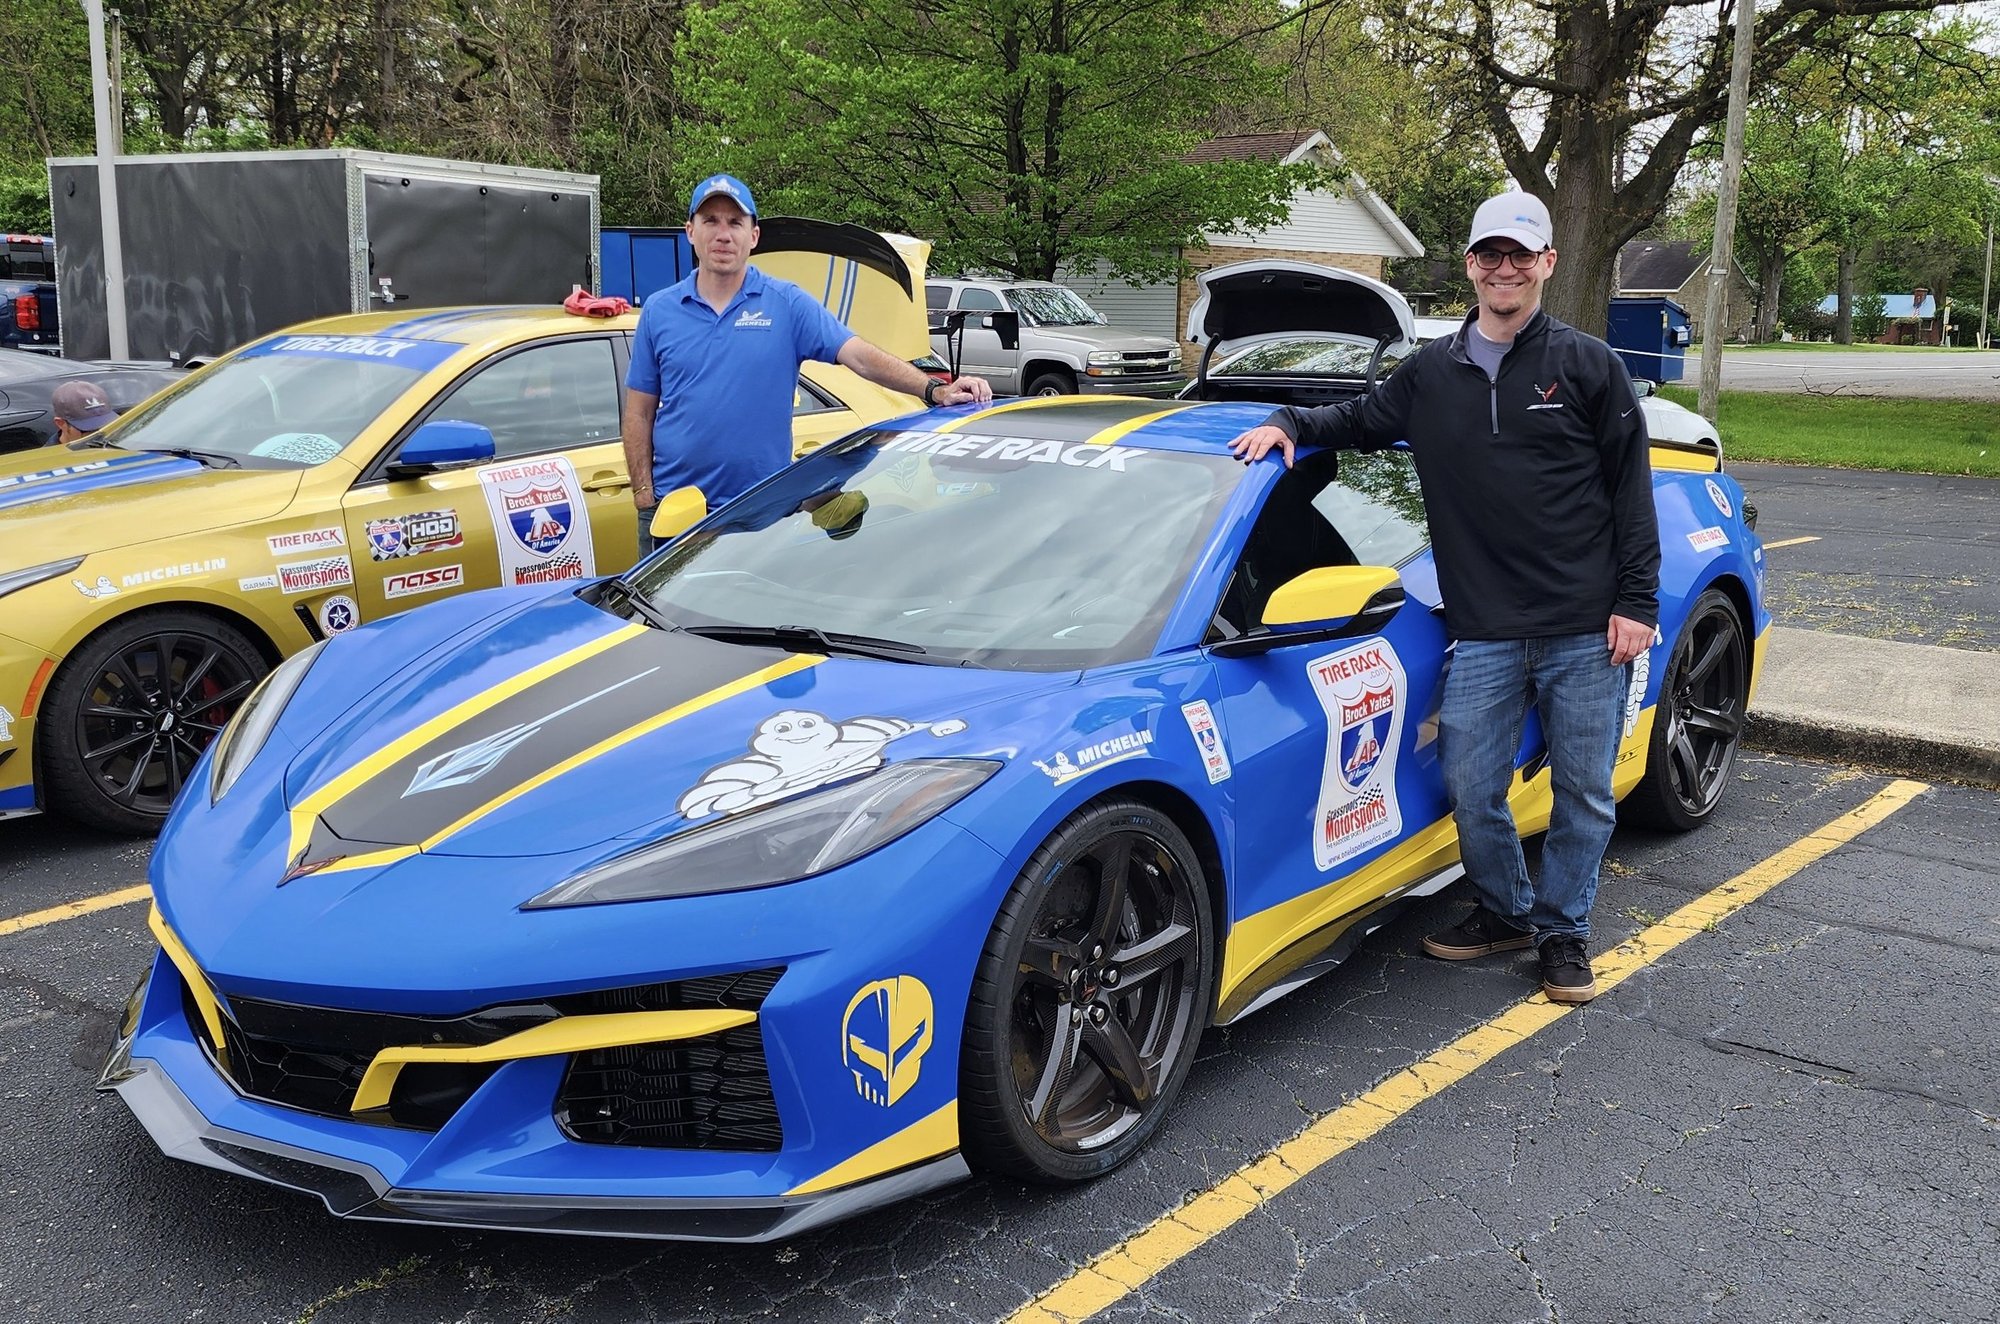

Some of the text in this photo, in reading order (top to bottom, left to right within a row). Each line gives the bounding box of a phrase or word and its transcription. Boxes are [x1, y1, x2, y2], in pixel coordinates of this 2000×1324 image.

[271, 336, 418, 358] TIRE RACK
[877, 431, 1149, 472] TIRE RACK
[488, 462, 565, 483] TIRE RACK
[508, 489, 564, 509] Brock Yates'
[411, 518, 453, 538] HOD
[529, 521, 561, 541] LAP
[269, 529, 343, 549] TIRE RACK
[122, 558, 226, 587] MICHELIN
[280, 563, 319, 576] Grassroots
[282, 566, 350, 588] Motorsports
[514, 560, 552, 576] Grassroots
[515, 562, 583, 585] Motorsports
[243, 581, 275, 590] GARMIN
[326, 598, 351, 610] PROJECT
[1318, 648, 1393, 686] TIRE RACK
[1370, 667, 1388, 680] .com
[1344, 690, 1393, 724] Brock Yates'
[1077, 729, 1153, 765] MICHELIN
[1349, 738, 1377, 770] LAP
[1325, 797, 1387, 844] Motorsports
[1326, 799, 1359, 822] Grassroots
[1077, 1128, 1117, 1147] CORVETTE
